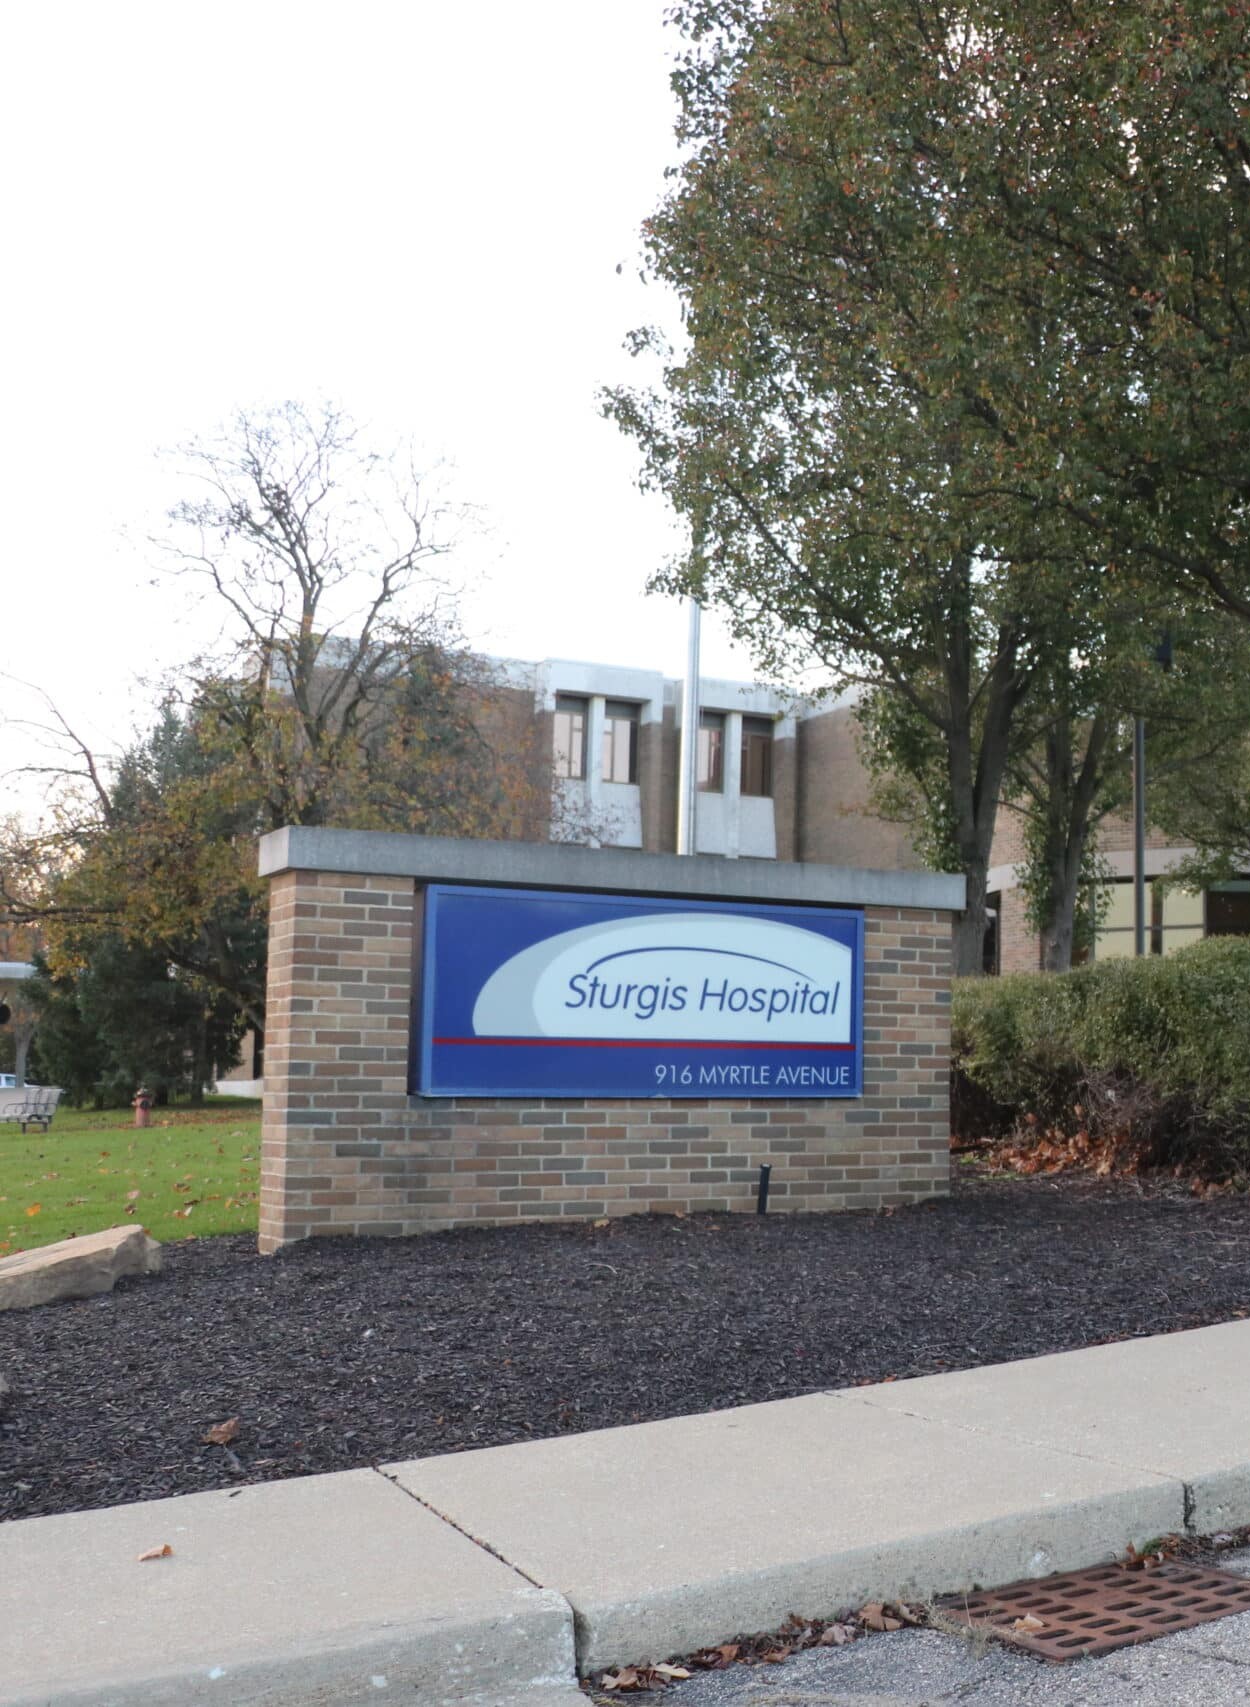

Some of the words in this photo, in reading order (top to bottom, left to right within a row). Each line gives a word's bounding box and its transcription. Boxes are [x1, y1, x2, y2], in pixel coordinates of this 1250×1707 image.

[565, 974, 688, 1020] Sturgis
[699, 978, 840, 1022] Hospital
[655, 1064, 693, 1085] 916
[699, 1065, 770, 1085] MYRTLE
[775, 1065, 850, 1085] AVENUE
